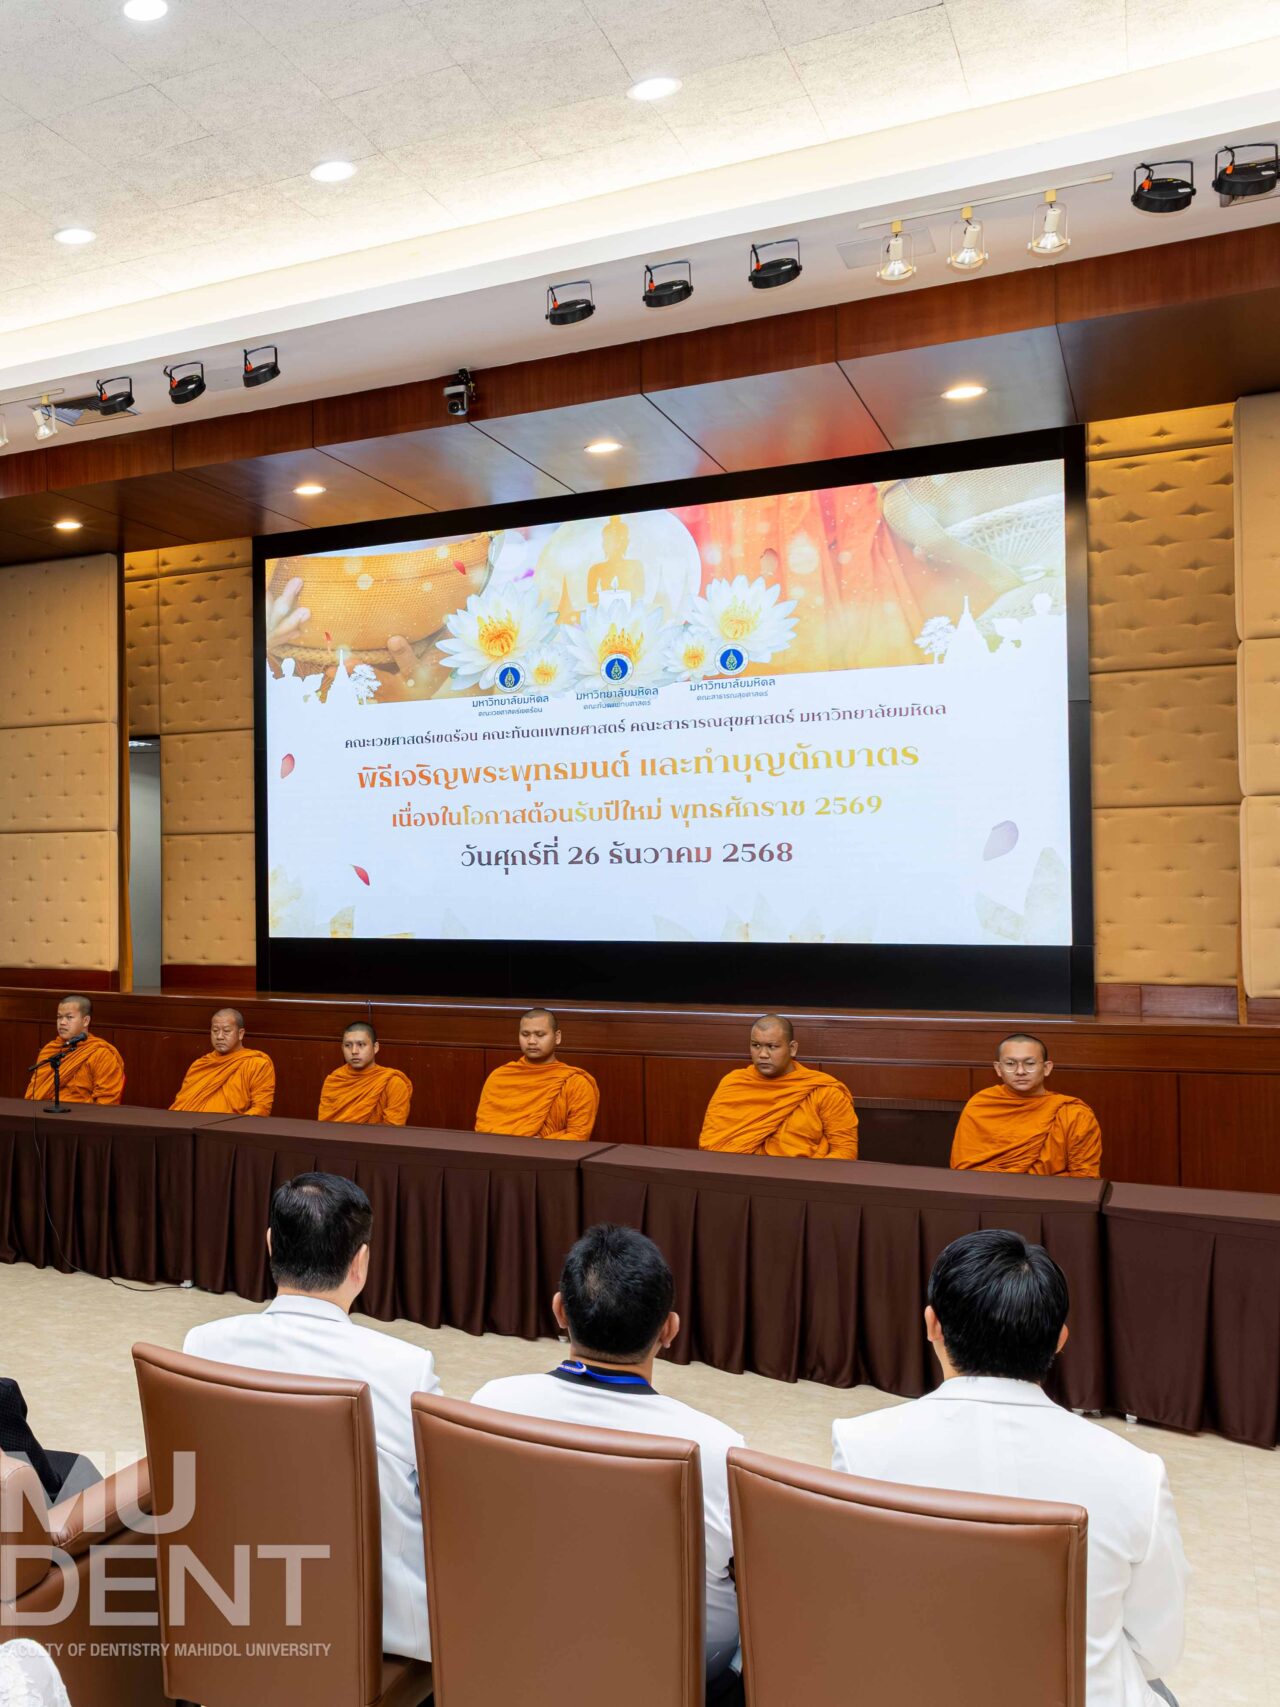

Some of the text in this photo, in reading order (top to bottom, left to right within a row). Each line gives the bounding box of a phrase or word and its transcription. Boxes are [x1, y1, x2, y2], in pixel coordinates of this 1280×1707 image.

[472, 694, 550, 708] มหาวิทยาลัยมหิดล
[576, 686, 659, 701] มหาวิทยาลัยมหิดล
[689, 677, 776, 692] มหาวิทยาลัยมหิดล
[344, 703, 947, 749] คณะเวชศาสตร์เขตร้อน คณะทันตแพทยศาสตร์ คณะสาธารณสุขศาสตร์ มหาวิทยาลัยมหิดล
[357, 742, 920, 792] พิธีเจริญพระพุทธมนต์ และทำบุญตักบาตร
[391, 795, 883, 828] เนื่องในโอกาสต้อนรับปีใหม่ พุทธศักราช 2569
[460, 835, 794, 876] วันศุกร์ที่ 26 ธันวาคม 2568
